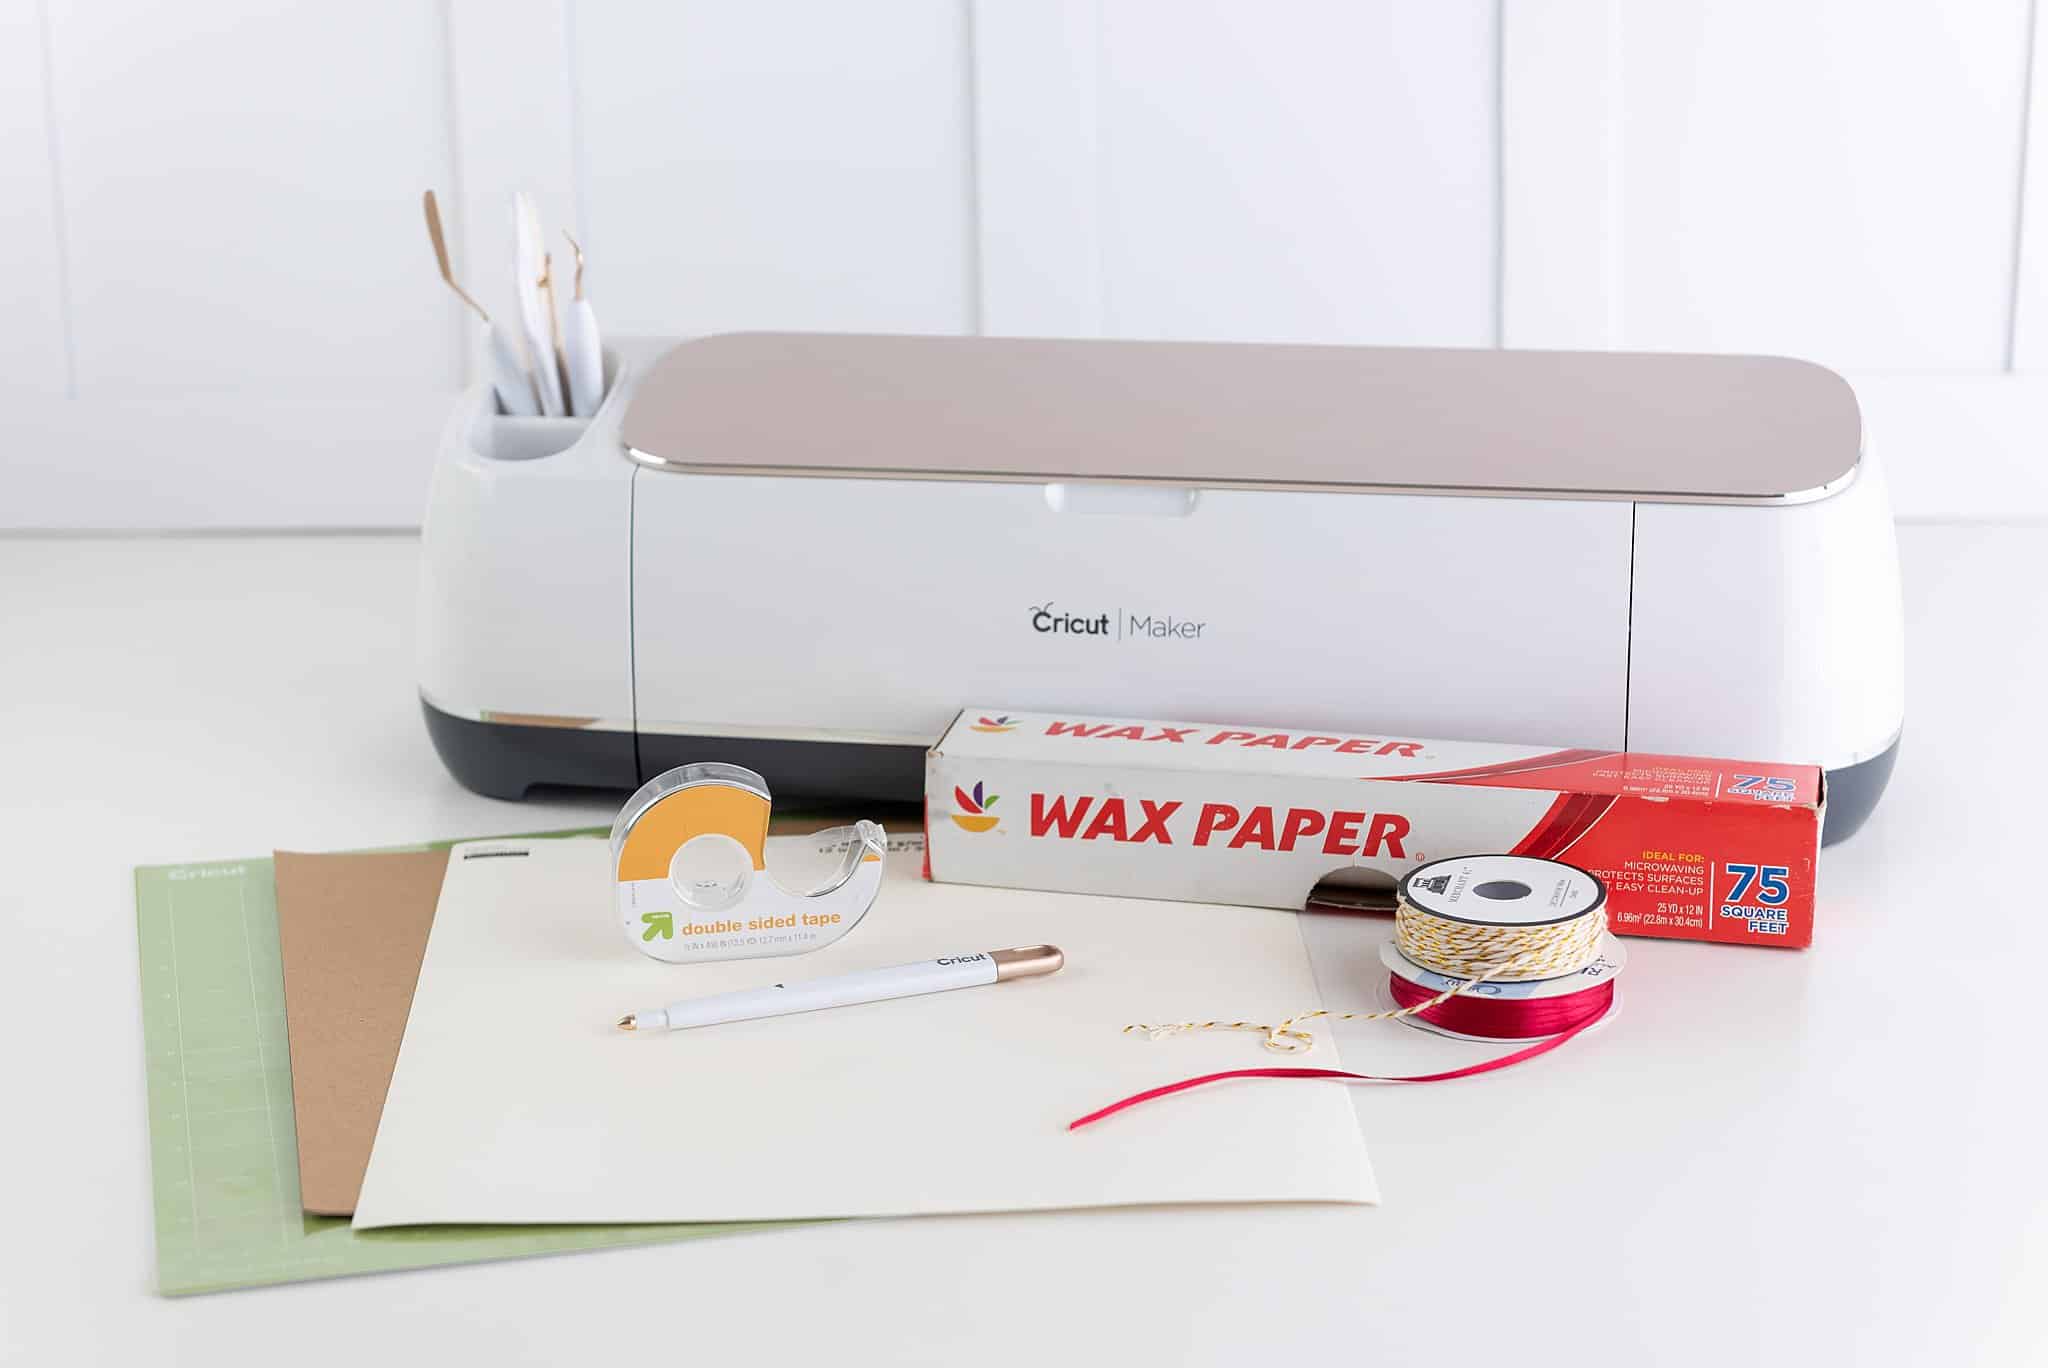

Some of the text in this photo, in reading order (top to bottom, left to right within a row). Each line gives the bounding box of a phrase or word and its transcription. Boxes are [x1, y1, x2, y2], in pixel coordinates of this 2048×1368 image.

[1030, 603, 1206, 639] Cricut Maker
[1044, 721, 1425, 759] WAX PAPER
[1733, 774, 1797, 791] 75
[1030, 792, 1411, 860] WAX PAPER
[1642, 851, 1705, 863] IDEAL FOR:
[1624, 861, 1704, 875] MICROWAVING
[1647, 873, 1704, 886] SURFACES
[1725, 862, 1790, 906] 75
[1615, 881, 1645, 892] EASY
[1647, 884, 1704, 897] CLEAN-UP
[1657, 902, 1667, 914] 25
[1668, 903, 1678, 914] YD
[1686, 904, 1695, 915] 12
[1695, 905, 1704, 916] IN
[1721, 906, 1787, 921] SQUARE
[682, 912, 841, 936] double sided tape
[1748, 920, 1789, 935] FEET
[937, 952, 987, 966] Cricut
